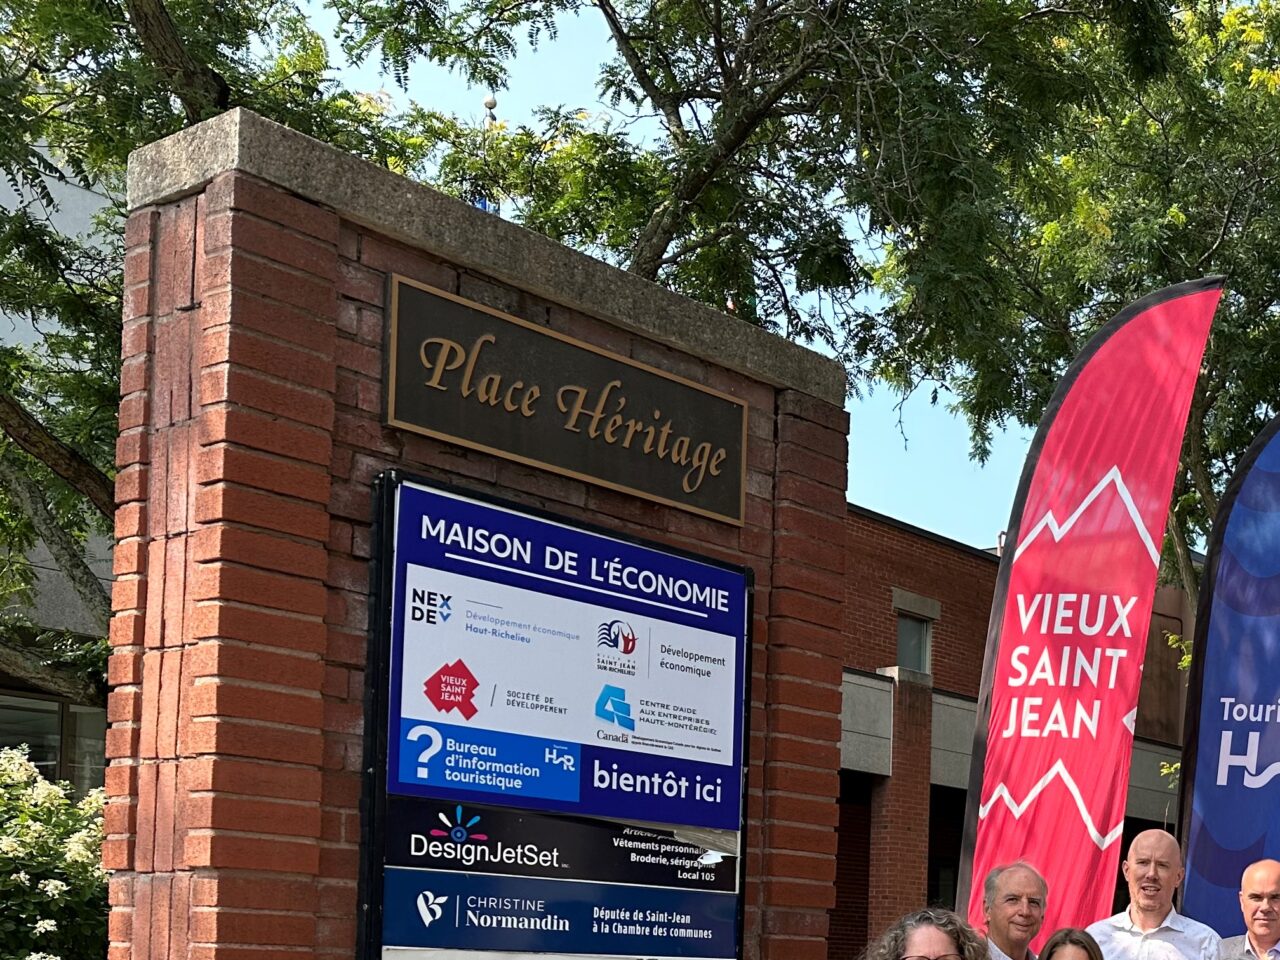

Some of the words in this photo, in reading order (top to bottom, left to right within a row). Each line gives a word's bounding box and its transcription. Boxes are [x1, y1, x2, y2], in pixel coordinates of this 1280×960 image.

[419, 334, 540, 418] Place
[557, 379, 727, 493] Héritage
[421, 514, 532, 564] MAISON
[545, 546, 578, 576] DE
[590, 557, 729, 612] L'ÉCONOMIE
[412, 588, 453, 610] NEX
[1016, 593, 1138, 637] VIEUX
[465, 623, 531, 643] Haut-Richelieu
[466, 610, 531, 630] Développement
[533, 625, 580, 641] économique
[660, 644, 726, 667] Développement
[660, 658, 712, 678] économique
[1007, 645, 1127, 689] SAINT
[440, 675, 467, 687] VIEUX
[440, 684, 466, 695] SAINT
[440, 692, 462, 703] JEAN
[506, 690, 540, 702] SOCIÉTÉ
[640, 699, 671, 711] CENTRE
[506, 699, 568, 715] DÉVELOPPEMENT
[640, 708, 656, 717] AUX
[658, 711, 710, 726] ENTREPRISES
[1002, 697, 1101, 740] JEAN
[446, 738, 497, 757] Bureau
[445, 755, 540, 778] d'information
[445, 769, 523, 791] touristique
[593, 759, 689, 799] bientôt
[695, 775, 722, 803] ici
[410, 834, 559, 868] DesignJetSet
[612, 837, 660, 851] Vêtements
[630, 852, 670, 866] Broderie,
[677, 870, 699, 880] Local
[701, 872, 715, 881] 105
[466, 896, 545, 912] CHRISTINE
[465, 910, 570, 932] Normandin
[593, 906, 630, 921] Députée
[633, 909, 643, 921] de
[646, 910, 691, 924] Saint-Jean
[592, 921, 598, 933] à
[601, 921, 609, 934] la
[612, 922, 650, 936] Chambre
[652, 924, 667, 937] des
[669, 927, 712, 939] communes
